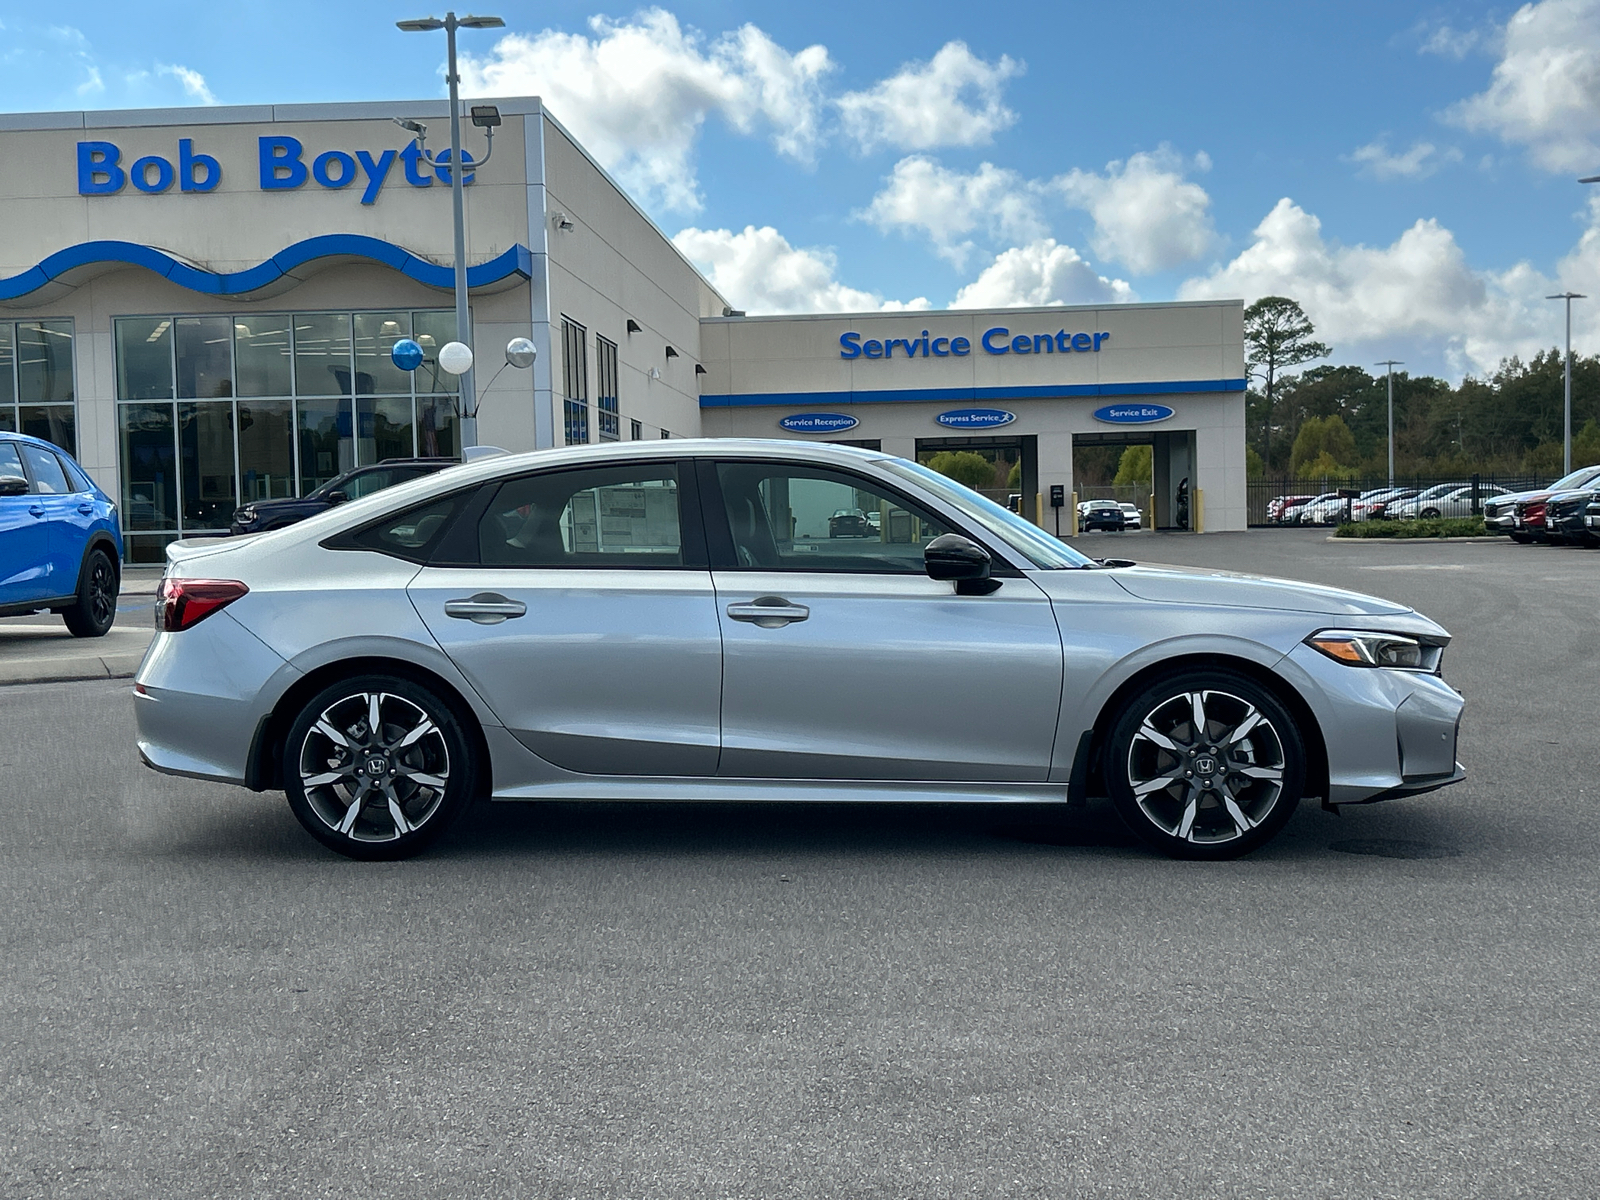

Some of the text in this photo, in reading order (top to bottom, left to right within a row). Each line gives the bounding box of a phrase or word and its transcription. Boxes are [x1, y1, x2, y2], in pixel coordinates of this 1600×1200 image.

[77, 136, 477, 205] Bob Boyte
[839, 327, 1110, 360] Service Center
[1109, 408, 1158, 417] Service Exit
[784, 418, 854, 427] Service Reception
[940, 414, 999, 424] Express Service
